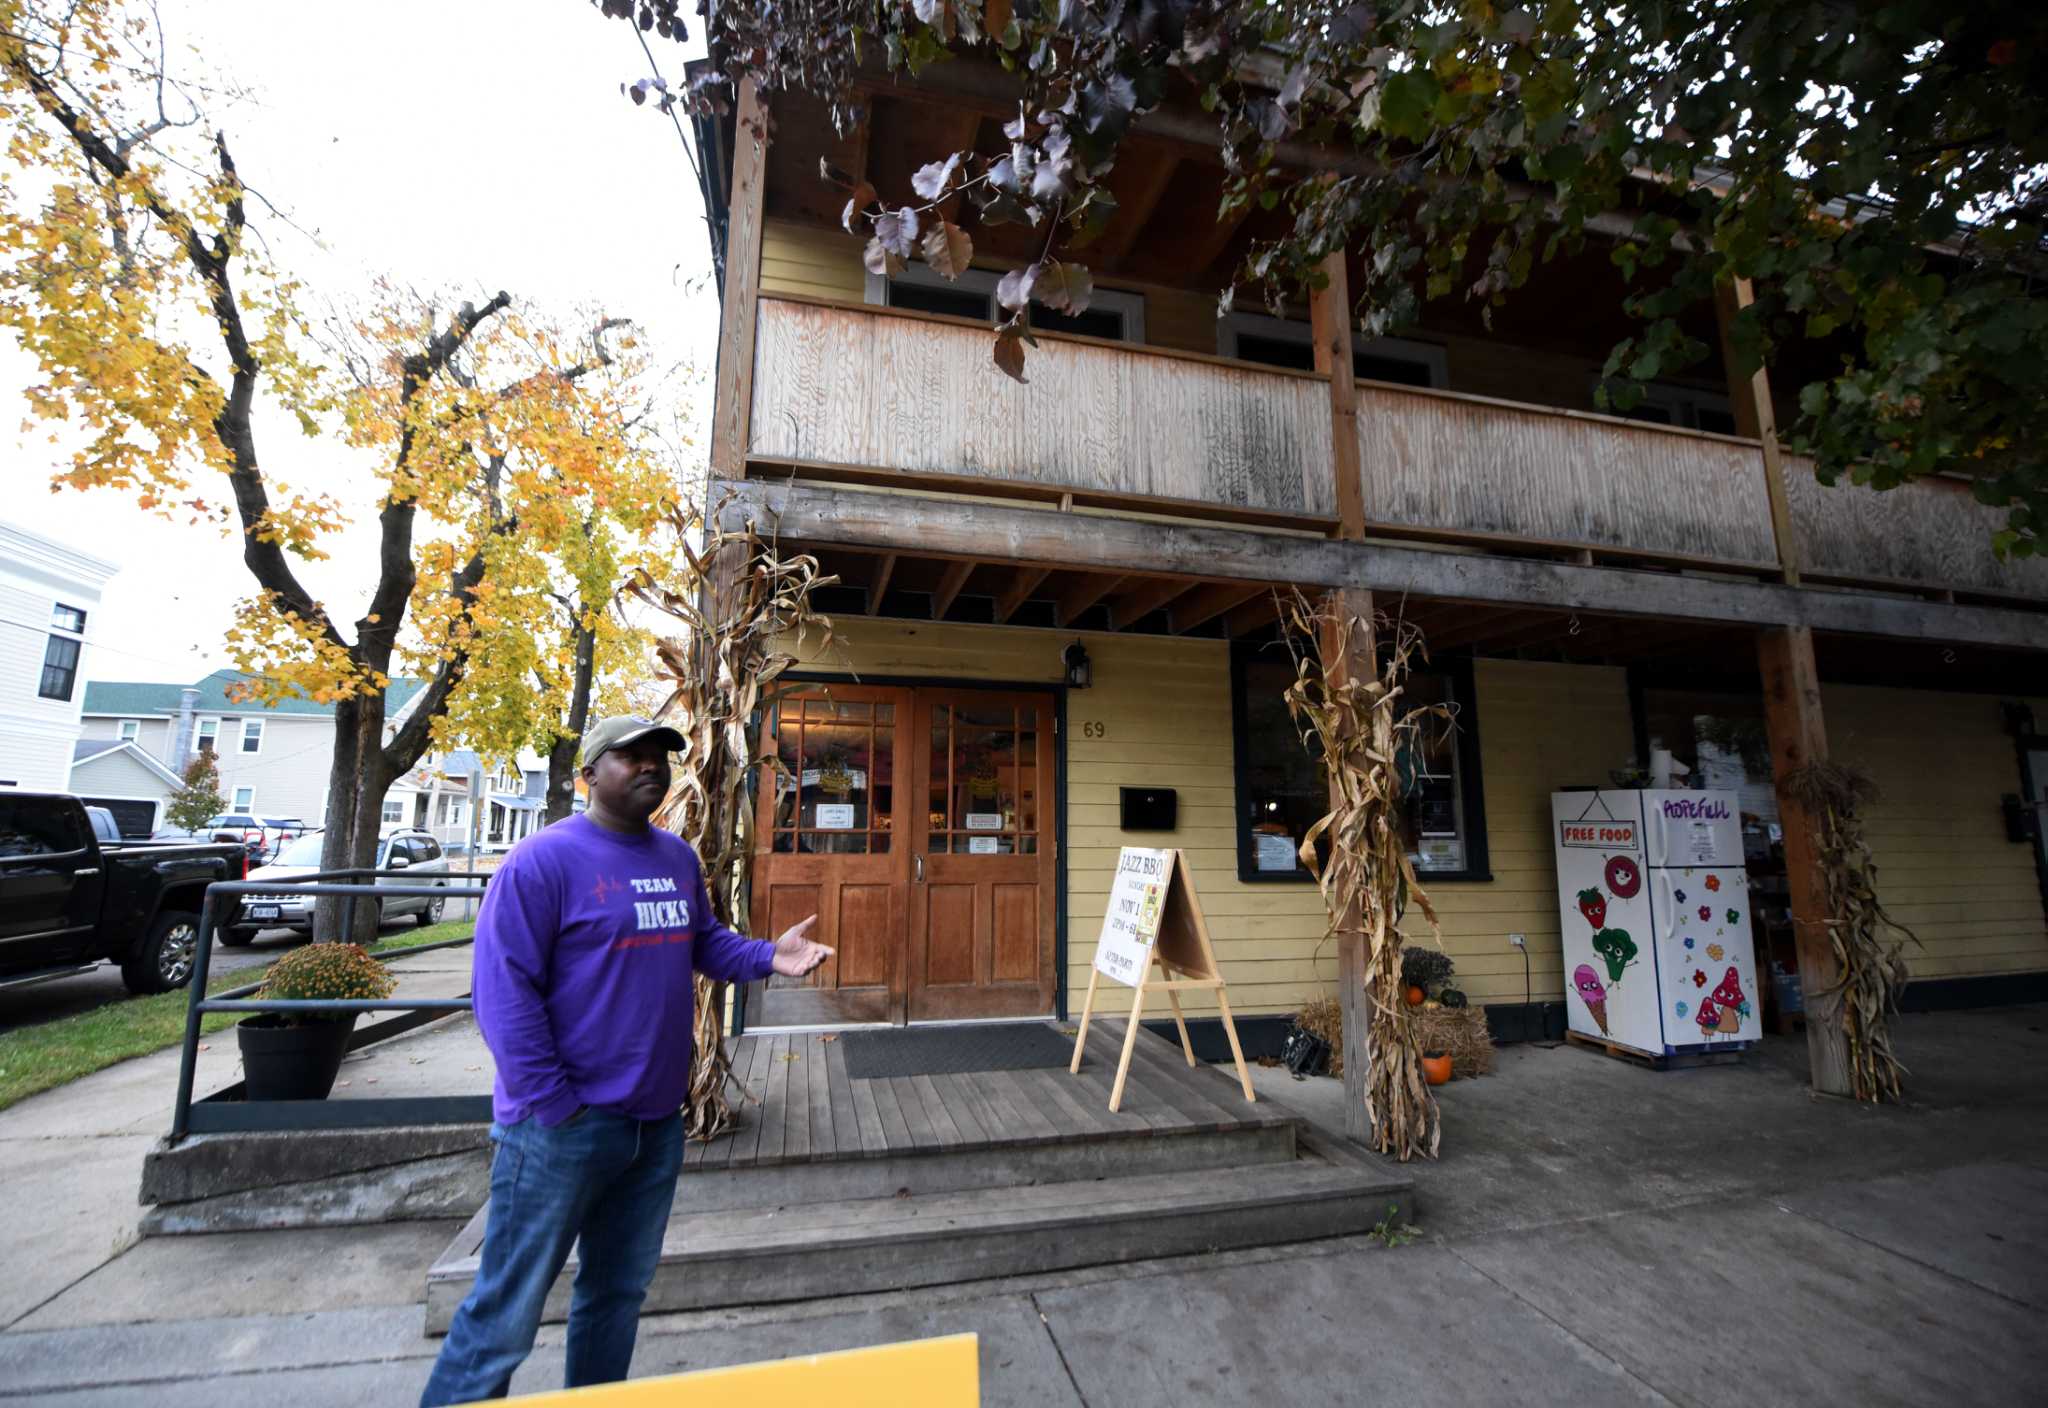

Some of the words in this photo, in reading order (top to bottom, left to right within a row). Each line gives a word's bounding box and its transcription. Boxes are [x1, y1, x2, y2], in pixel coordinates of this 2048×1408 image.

[1083, 721, 1105, 738] 69
[1565, 827, 1595, 841] FREE
[1600, 828, 1632, 842] FOOD
[1119, 854, 1142, 875] JAZZ
[1142, 857, 1163, 882] BBQ
[630, 877, 677, 893] TEAM
[633, 900, 690, 930] HICKS
